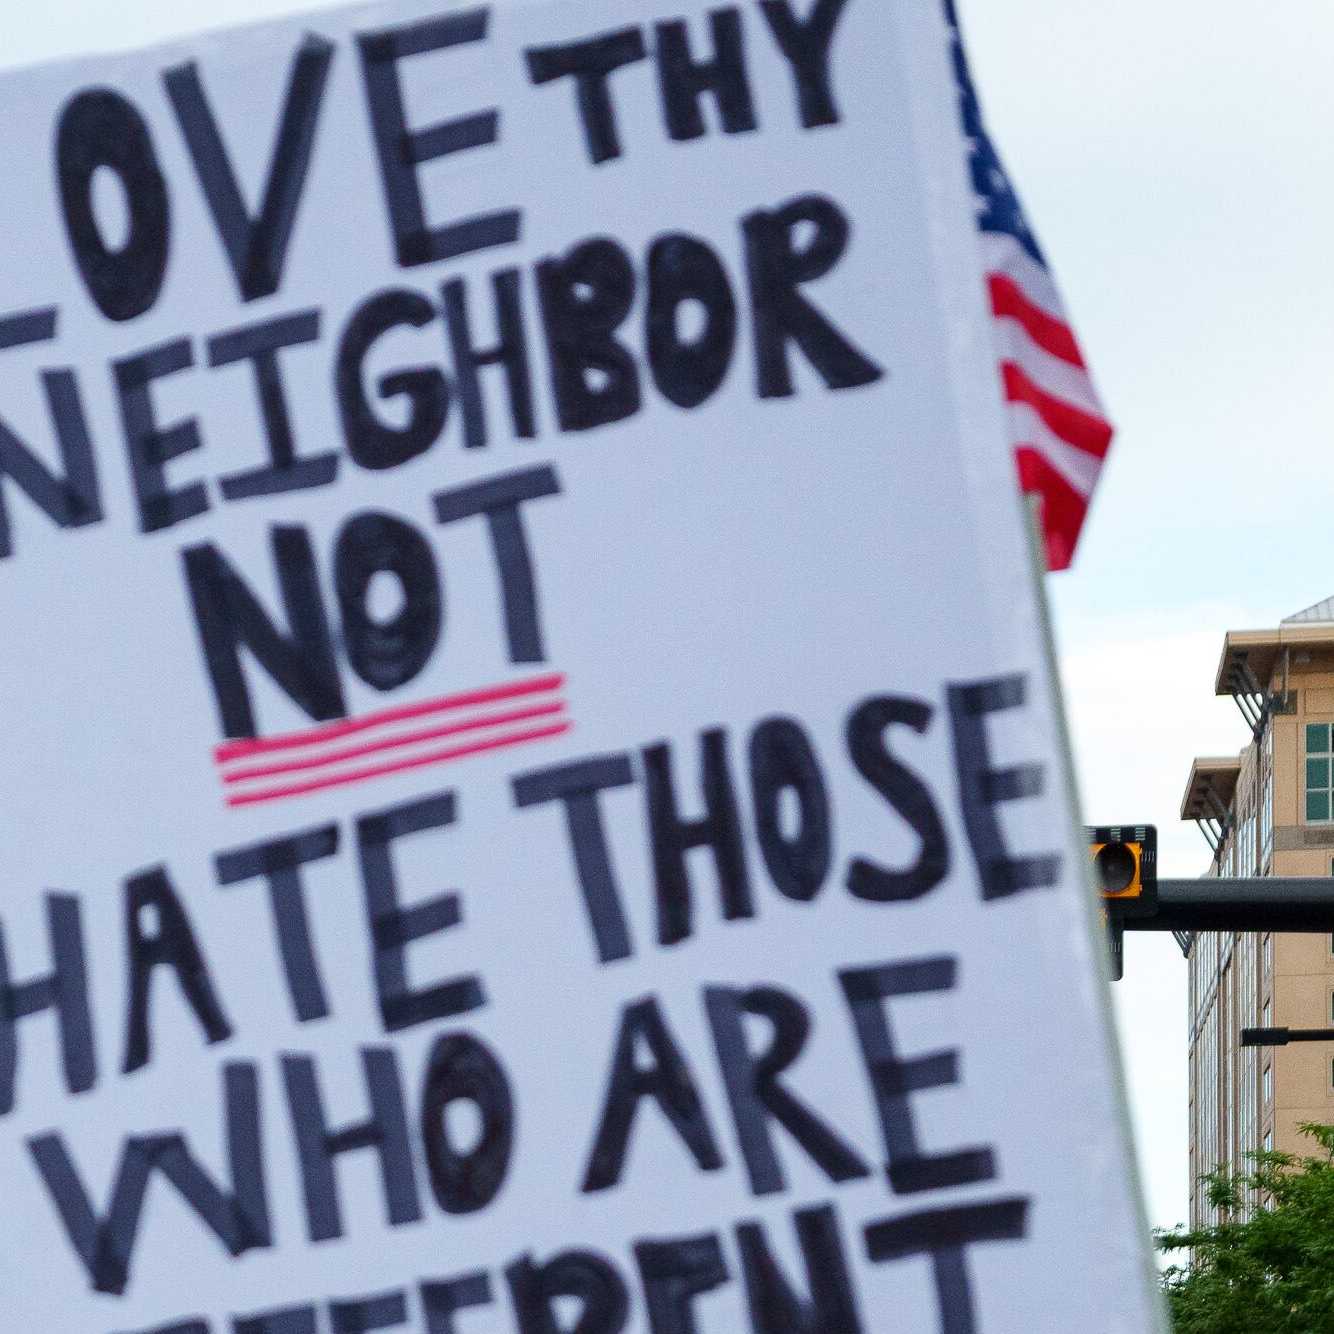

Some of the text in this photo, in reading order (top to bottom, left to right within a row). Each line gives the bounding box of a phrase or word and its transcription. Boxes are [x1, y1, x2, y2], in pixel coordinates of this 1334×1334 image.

[525, 0, 849, 165] THY
[182, 465, 561, 741] NOT
[513, 672, 1061, 964] THOSE
[26, 956, 996, 1298] WHO ARE
